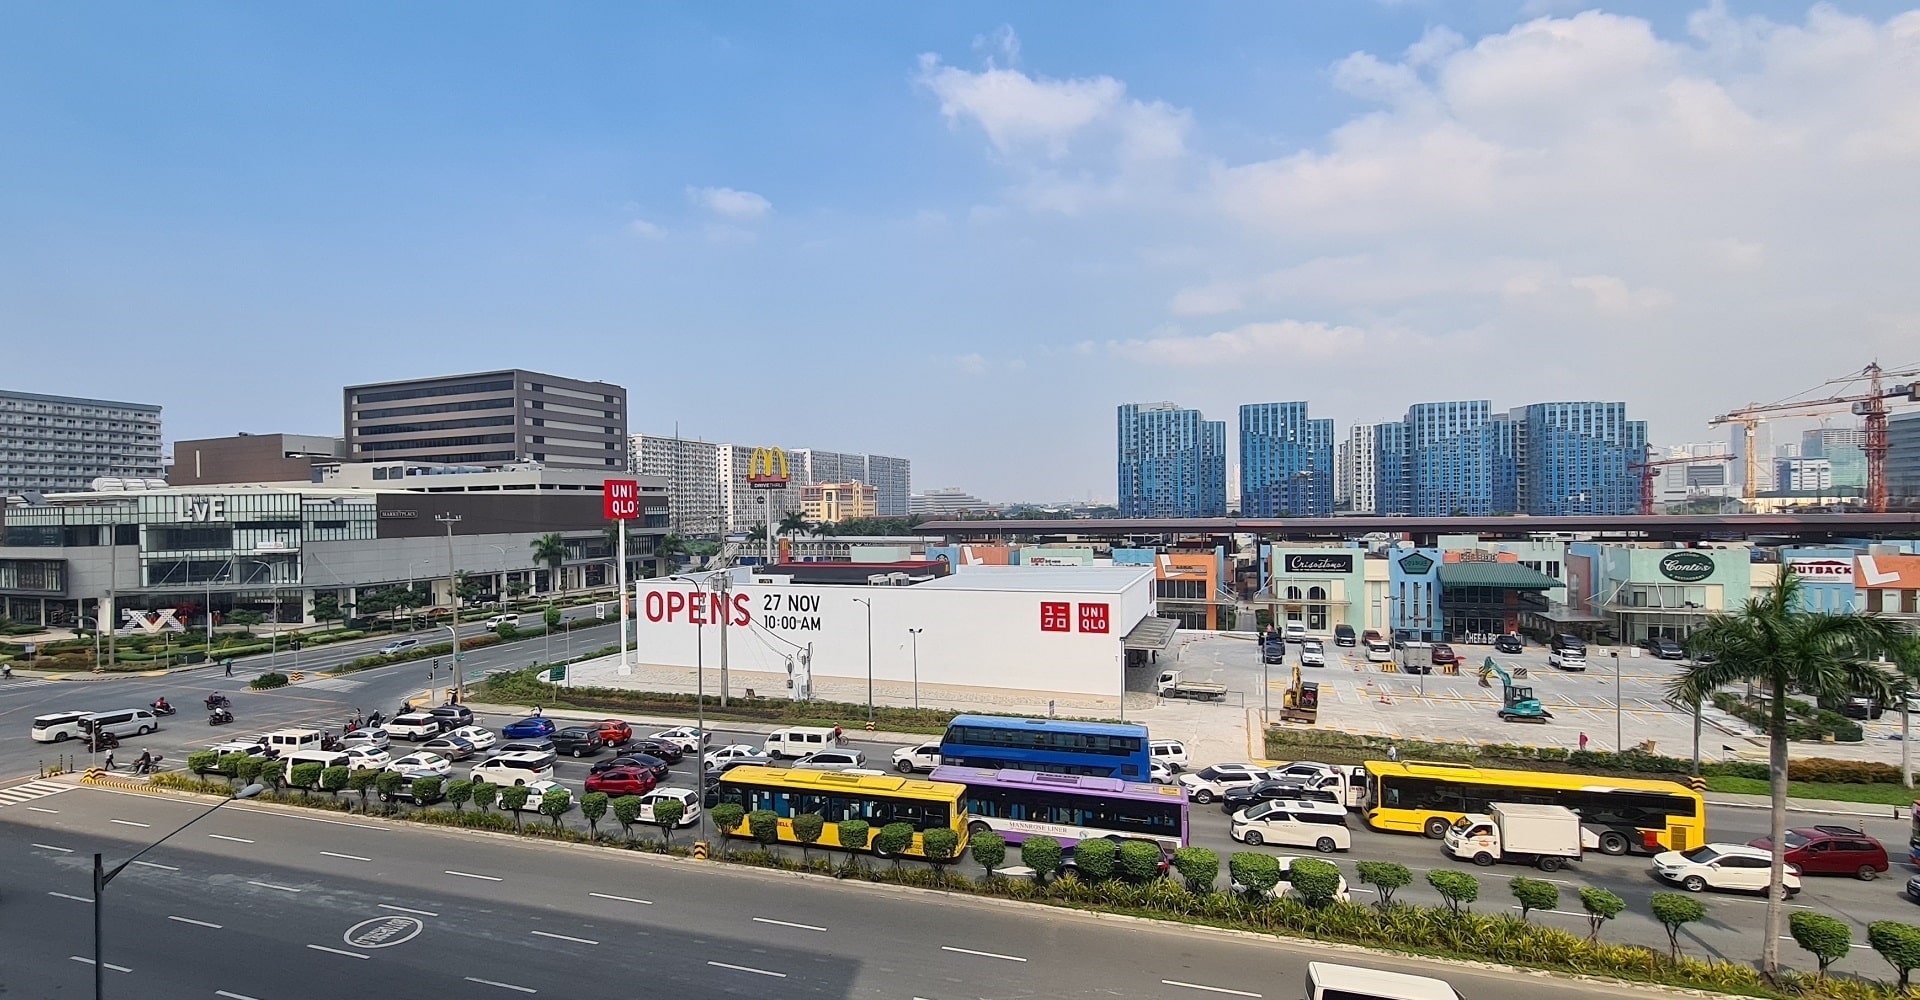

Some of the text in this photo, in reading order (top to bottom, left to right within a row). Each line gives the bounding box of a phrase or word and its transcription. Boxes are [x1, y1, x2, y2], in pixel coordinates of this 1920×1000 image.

[611, 484, 633, 498] UNI
[612, 500, 635, 516] QLO
[1789, 566, 1852, 574] OUTBACK
[645, 591, 751, 627] OPENS
[763, 594, 821, 613] 27 NOV
[1081, 606, 1104, 618] UNI
[764, 615, 821, 631] 10:00 AM
[1082, 619, 1106, 631] QLO
